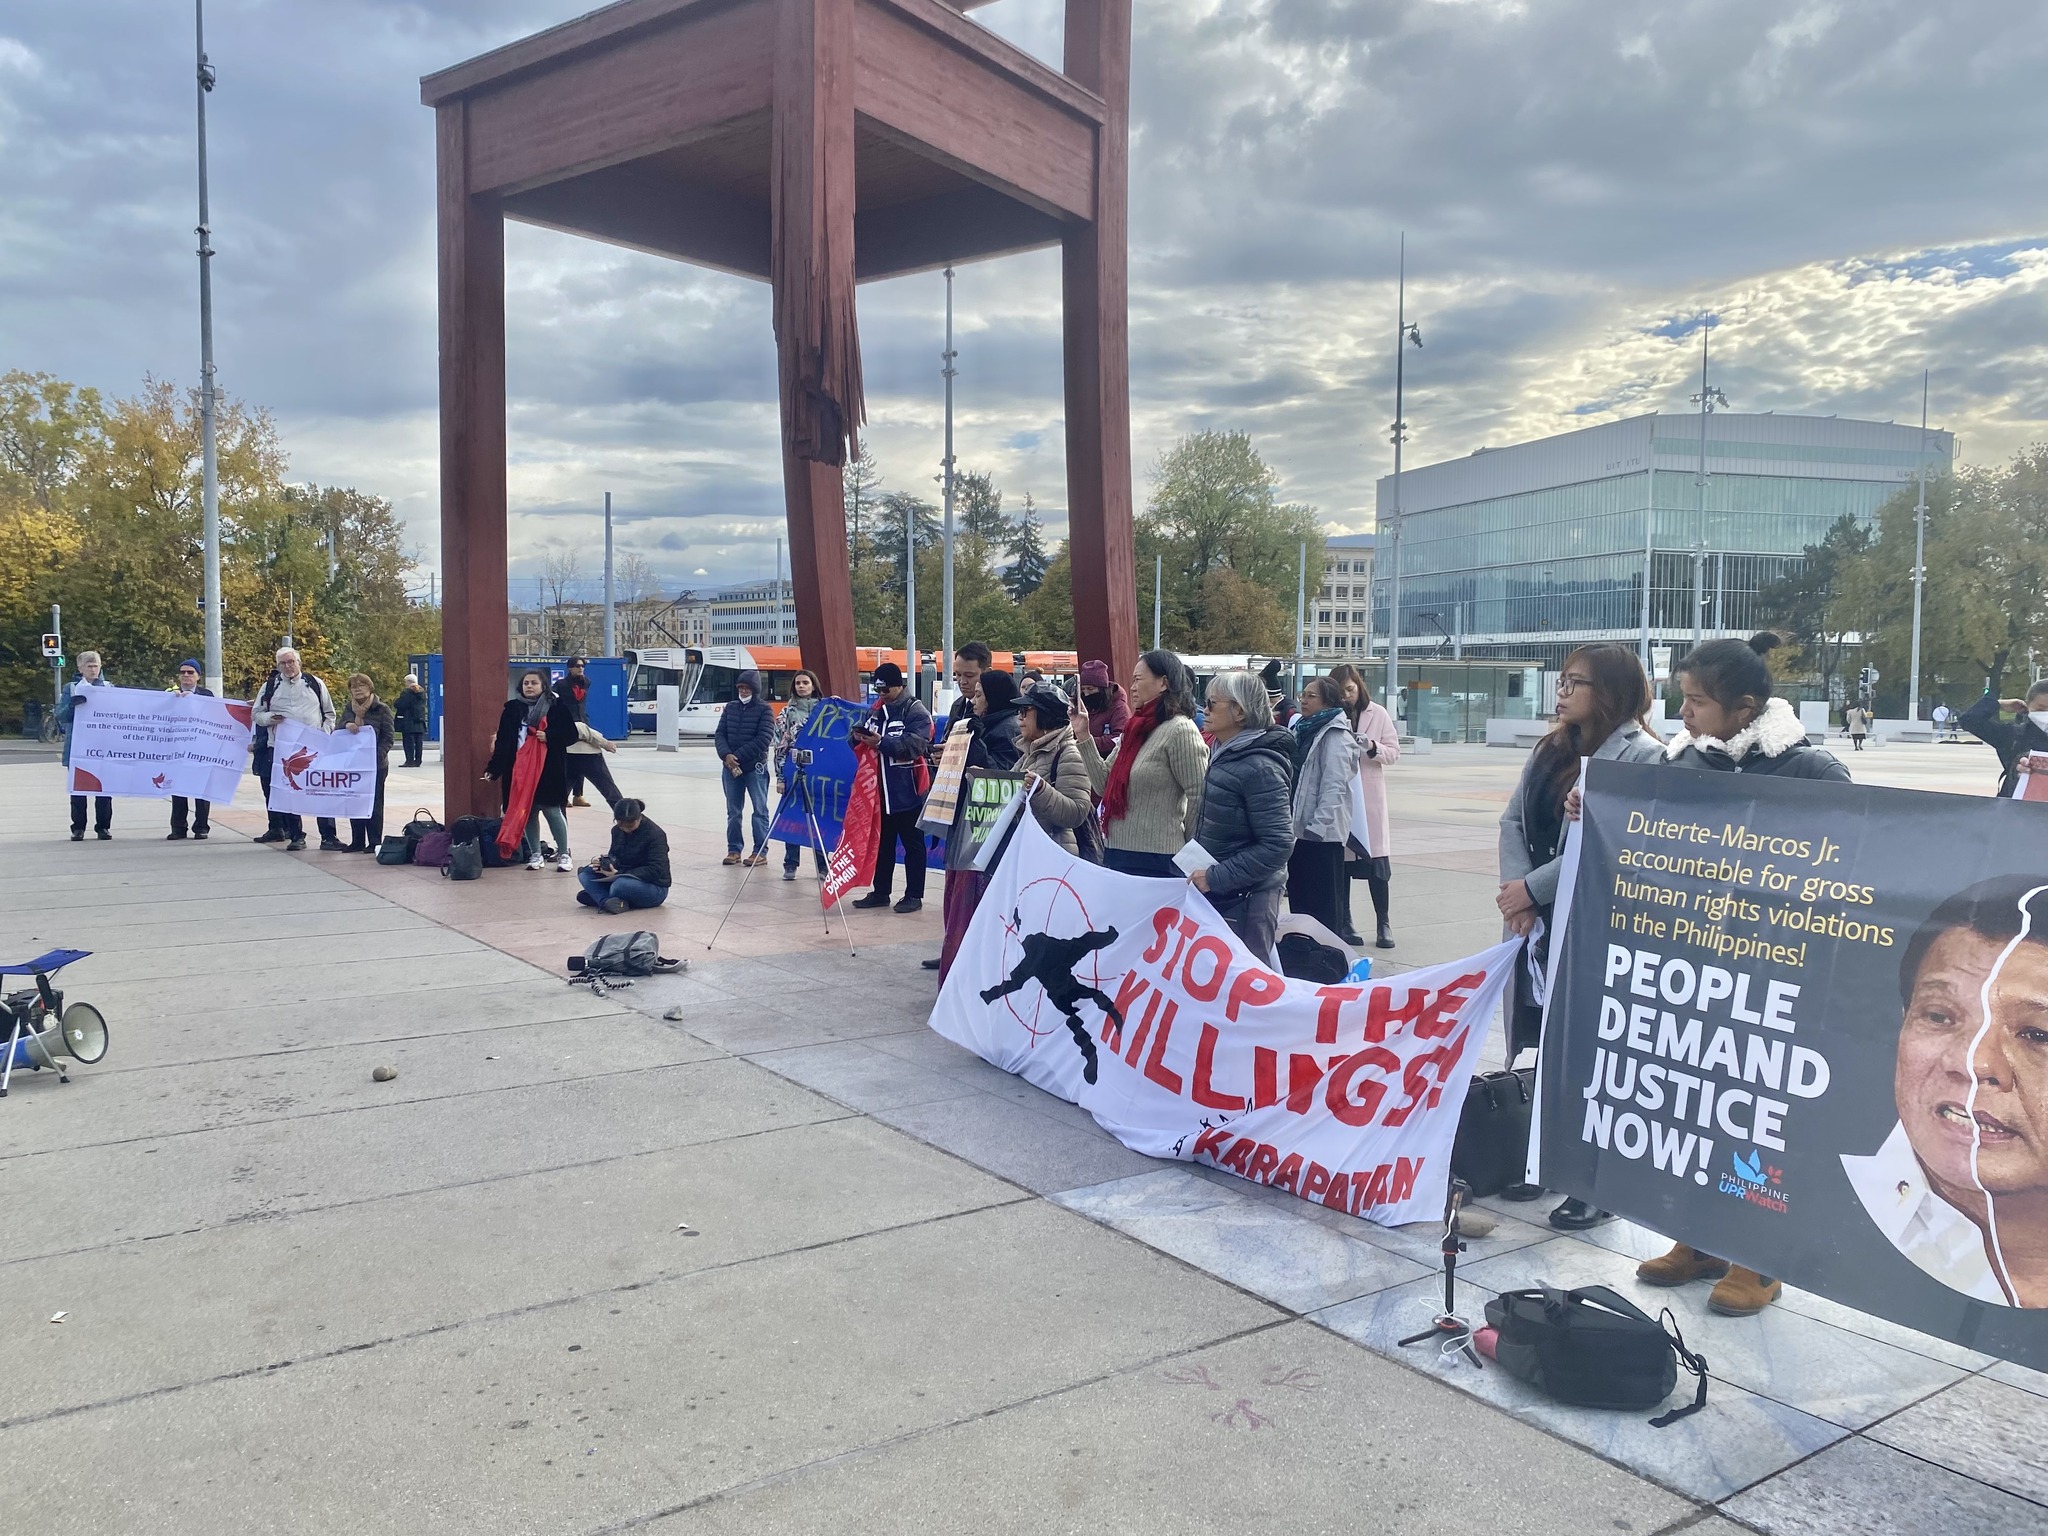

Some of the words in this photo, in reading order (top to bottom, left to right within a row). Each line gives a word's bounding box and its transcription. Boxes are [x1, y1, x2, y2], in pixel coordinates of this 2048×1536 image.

[93, 710, 137, 720] Investigate
[137, 713, 151, 721] the
[188, 716, 233, 731] government
[112, 723, 155, 733] continuing
[198, 728, 212, 737] the
[212, 731, 235, 742] rights
[86, 748, 105, 758] ICC,
[106, 750, 136, 759] Arrest
[174, 751, 186, 760] End
[187, 751, 234, 767] Impunity!
[305, 770, 362, 788] ICHRP
[1626, 811, 1811, 859] Duterte-Marcos
[1811, 837, 1841, 867] Jr.
[1618, 848, 1753, 885] accountable
[1759, 863, 1798, 892] for
[1800, 875, 1875, 905] gross
[1610, 905, 1627, 930] in
[1633, 911, 1667, 939] the
[1672, 918, 1808, 968] Philippines!
[1613, 874, 1687, 909] human
[1693, 889, 1761, 922] rights
[1767, 902, 1895, 947] violations
[1142, 907, 1287, 1022] STOP
[1315, 970, 1487, 1044] THE
[1604, 943, 1801, 1034] PEOPLE
[1597, 995, 1831, 1099] DEMAND
[1583, 1047, 1790, 1152] JUSTICE
[1192, 1127, 1426, 1217] KARAPATAN
[1581, 1098, 1714, 1186] NOW!
[1721, 1172, 1790, 1203] PHILIPPINE
